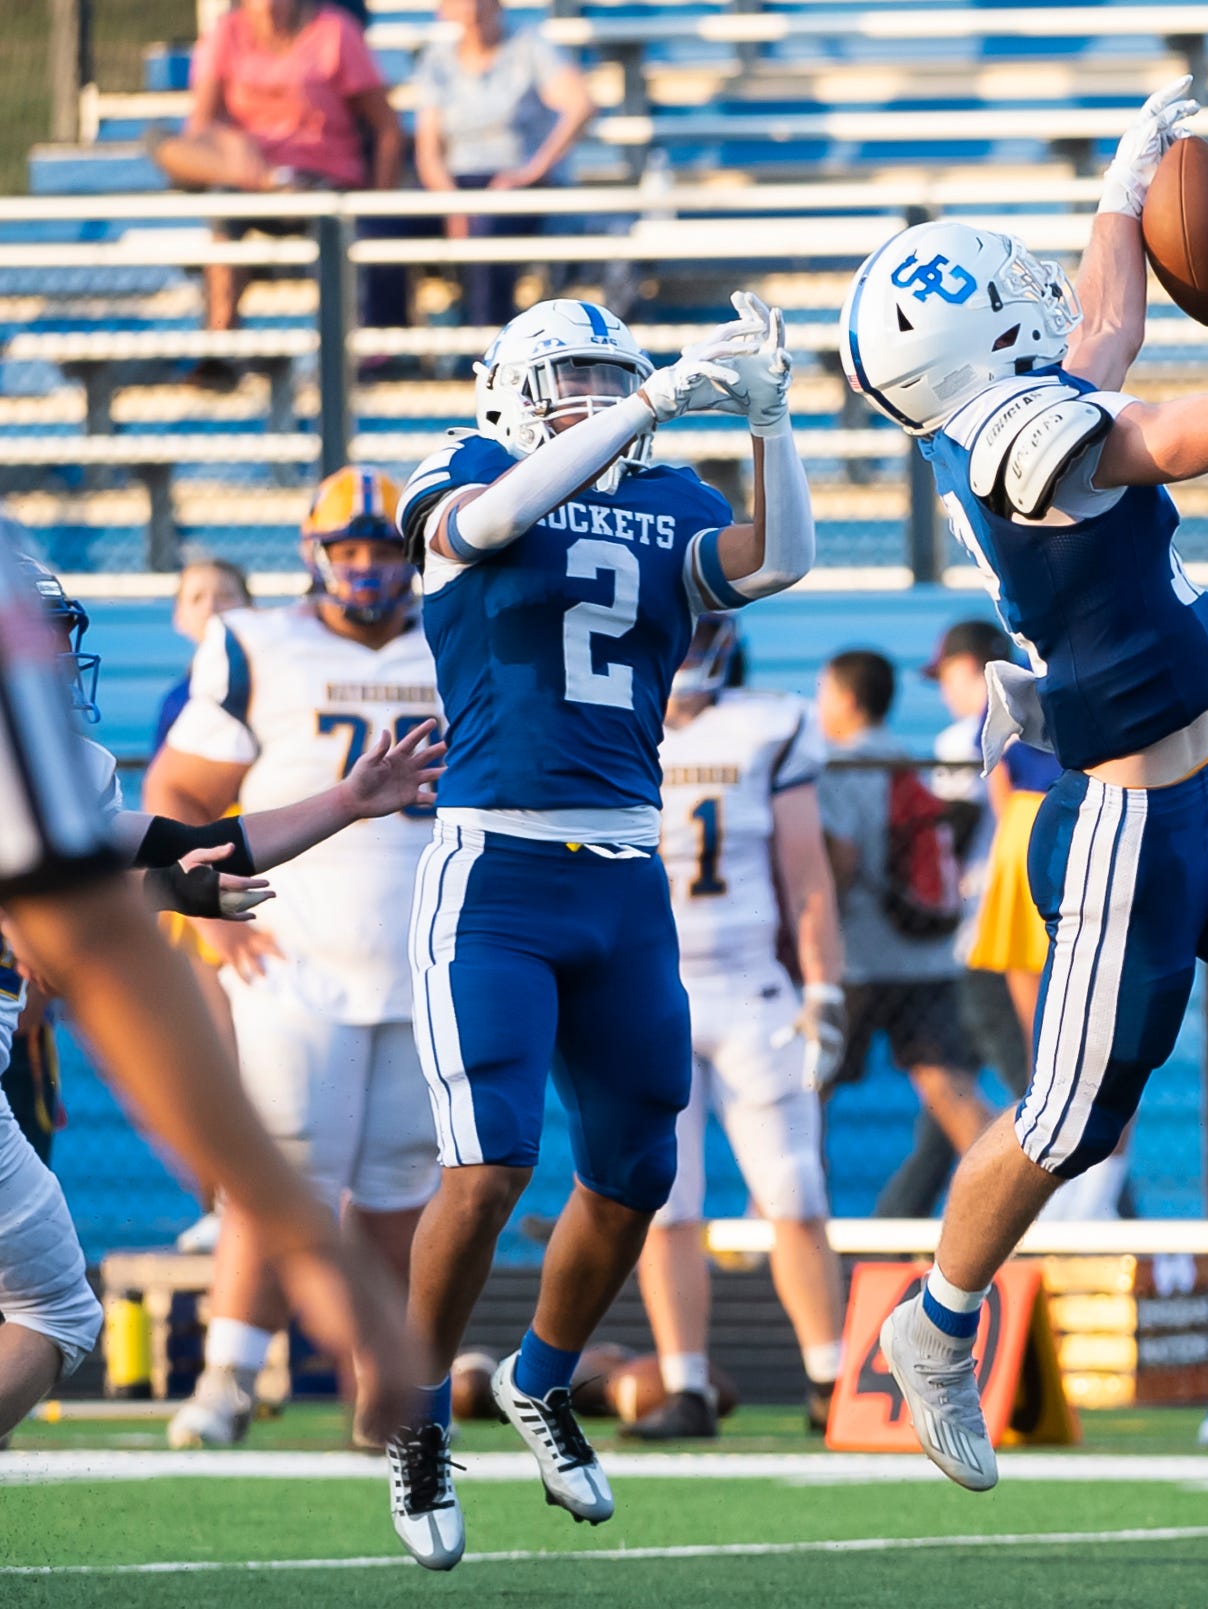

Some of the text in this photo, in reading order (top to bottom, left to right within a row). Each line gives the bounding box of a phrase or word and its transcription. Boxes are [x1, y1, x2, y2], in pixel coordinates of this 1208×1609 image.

[537, 501, 676, 550] OCKETS
[563, 538, 641, 711] 2
[689, 797, 728, 898] 1
